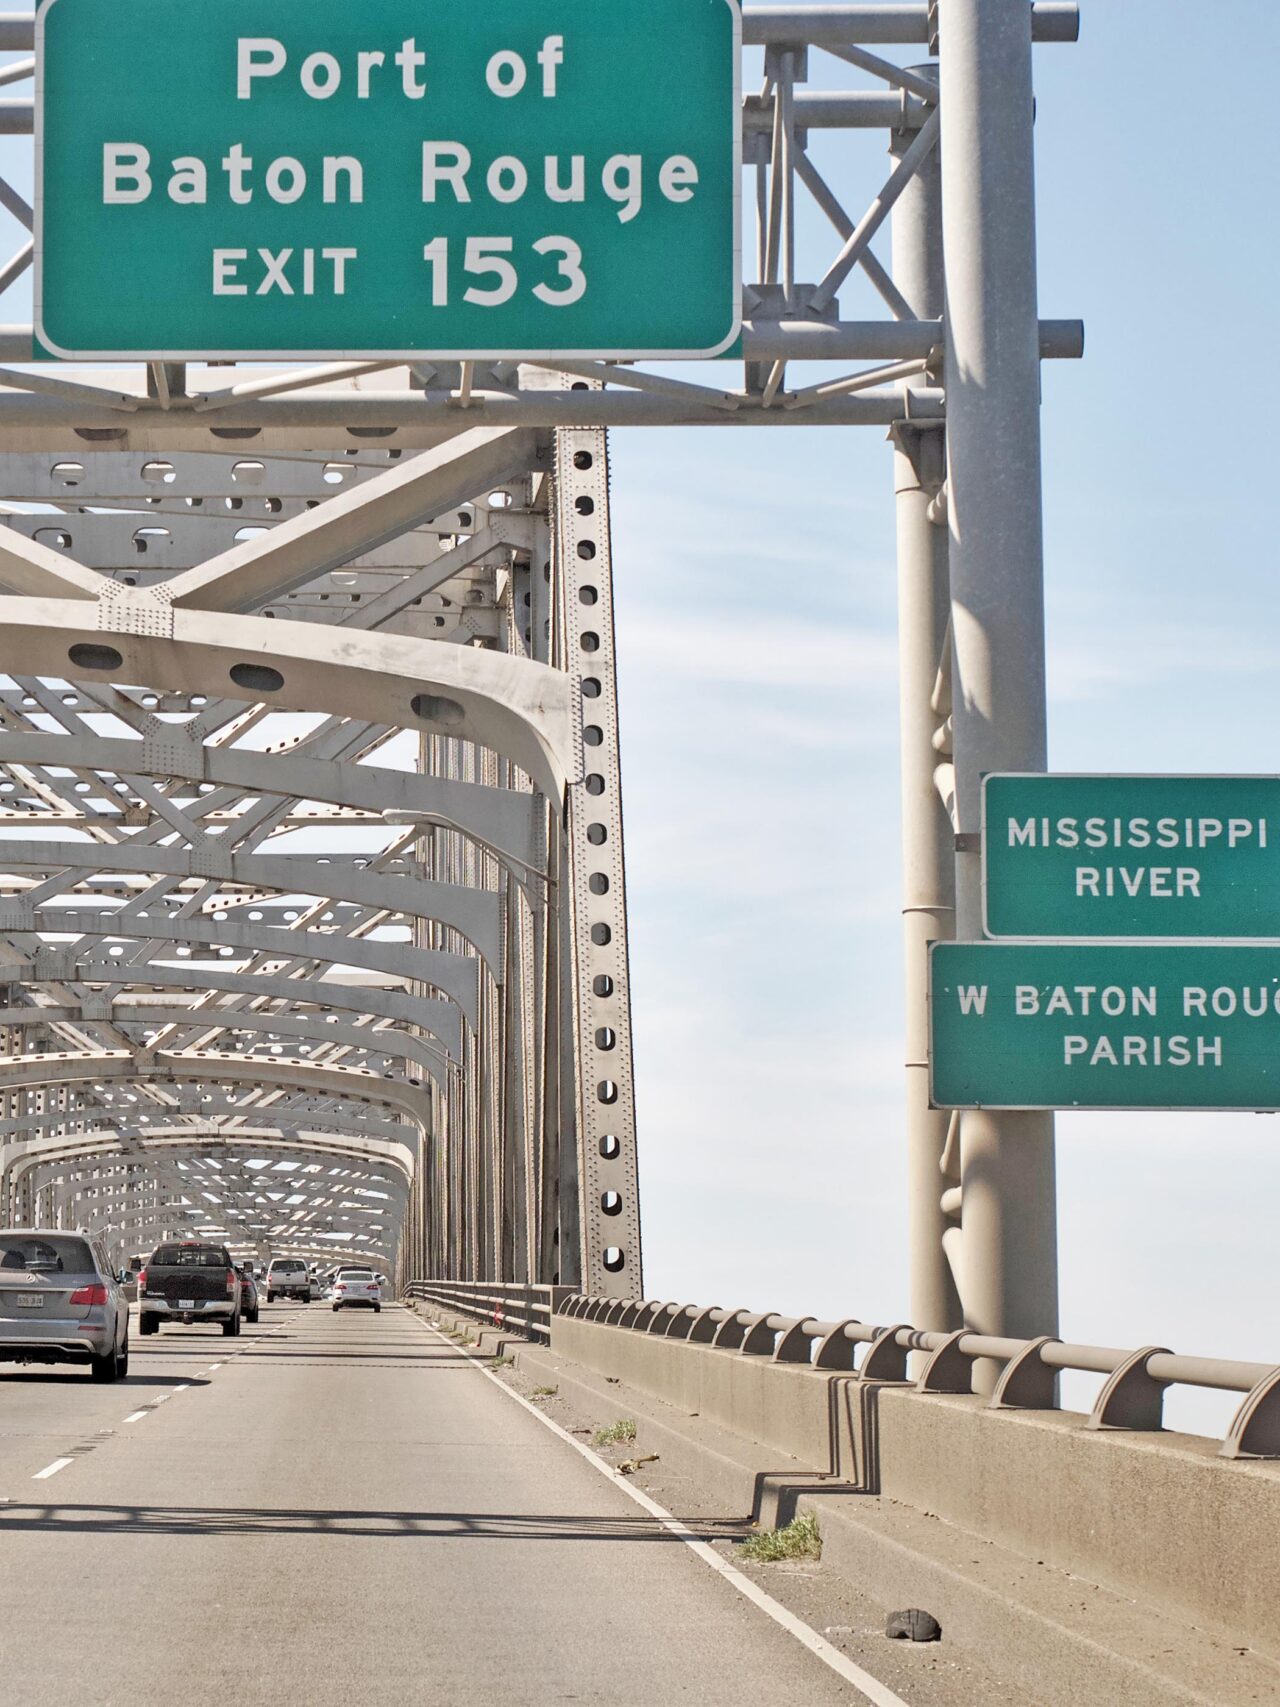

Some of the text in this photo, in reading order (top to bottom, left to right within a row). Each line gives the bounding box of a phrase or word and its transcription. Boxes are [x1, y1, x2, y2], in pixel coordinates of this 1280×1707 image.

[236, 34, 564, 100] Port of
[102, 140, 699, 224] Baton Rouge
[211, 235, 587, 307] EXIT 153
[1007, 817, 1267, 848] MISSISSIPPI
[1075, 866, 1201, 897] RIVER
[957, 985, 1280, 1017] W BATON ROU
[1063, 1035, 1222, 1066] PARISH
